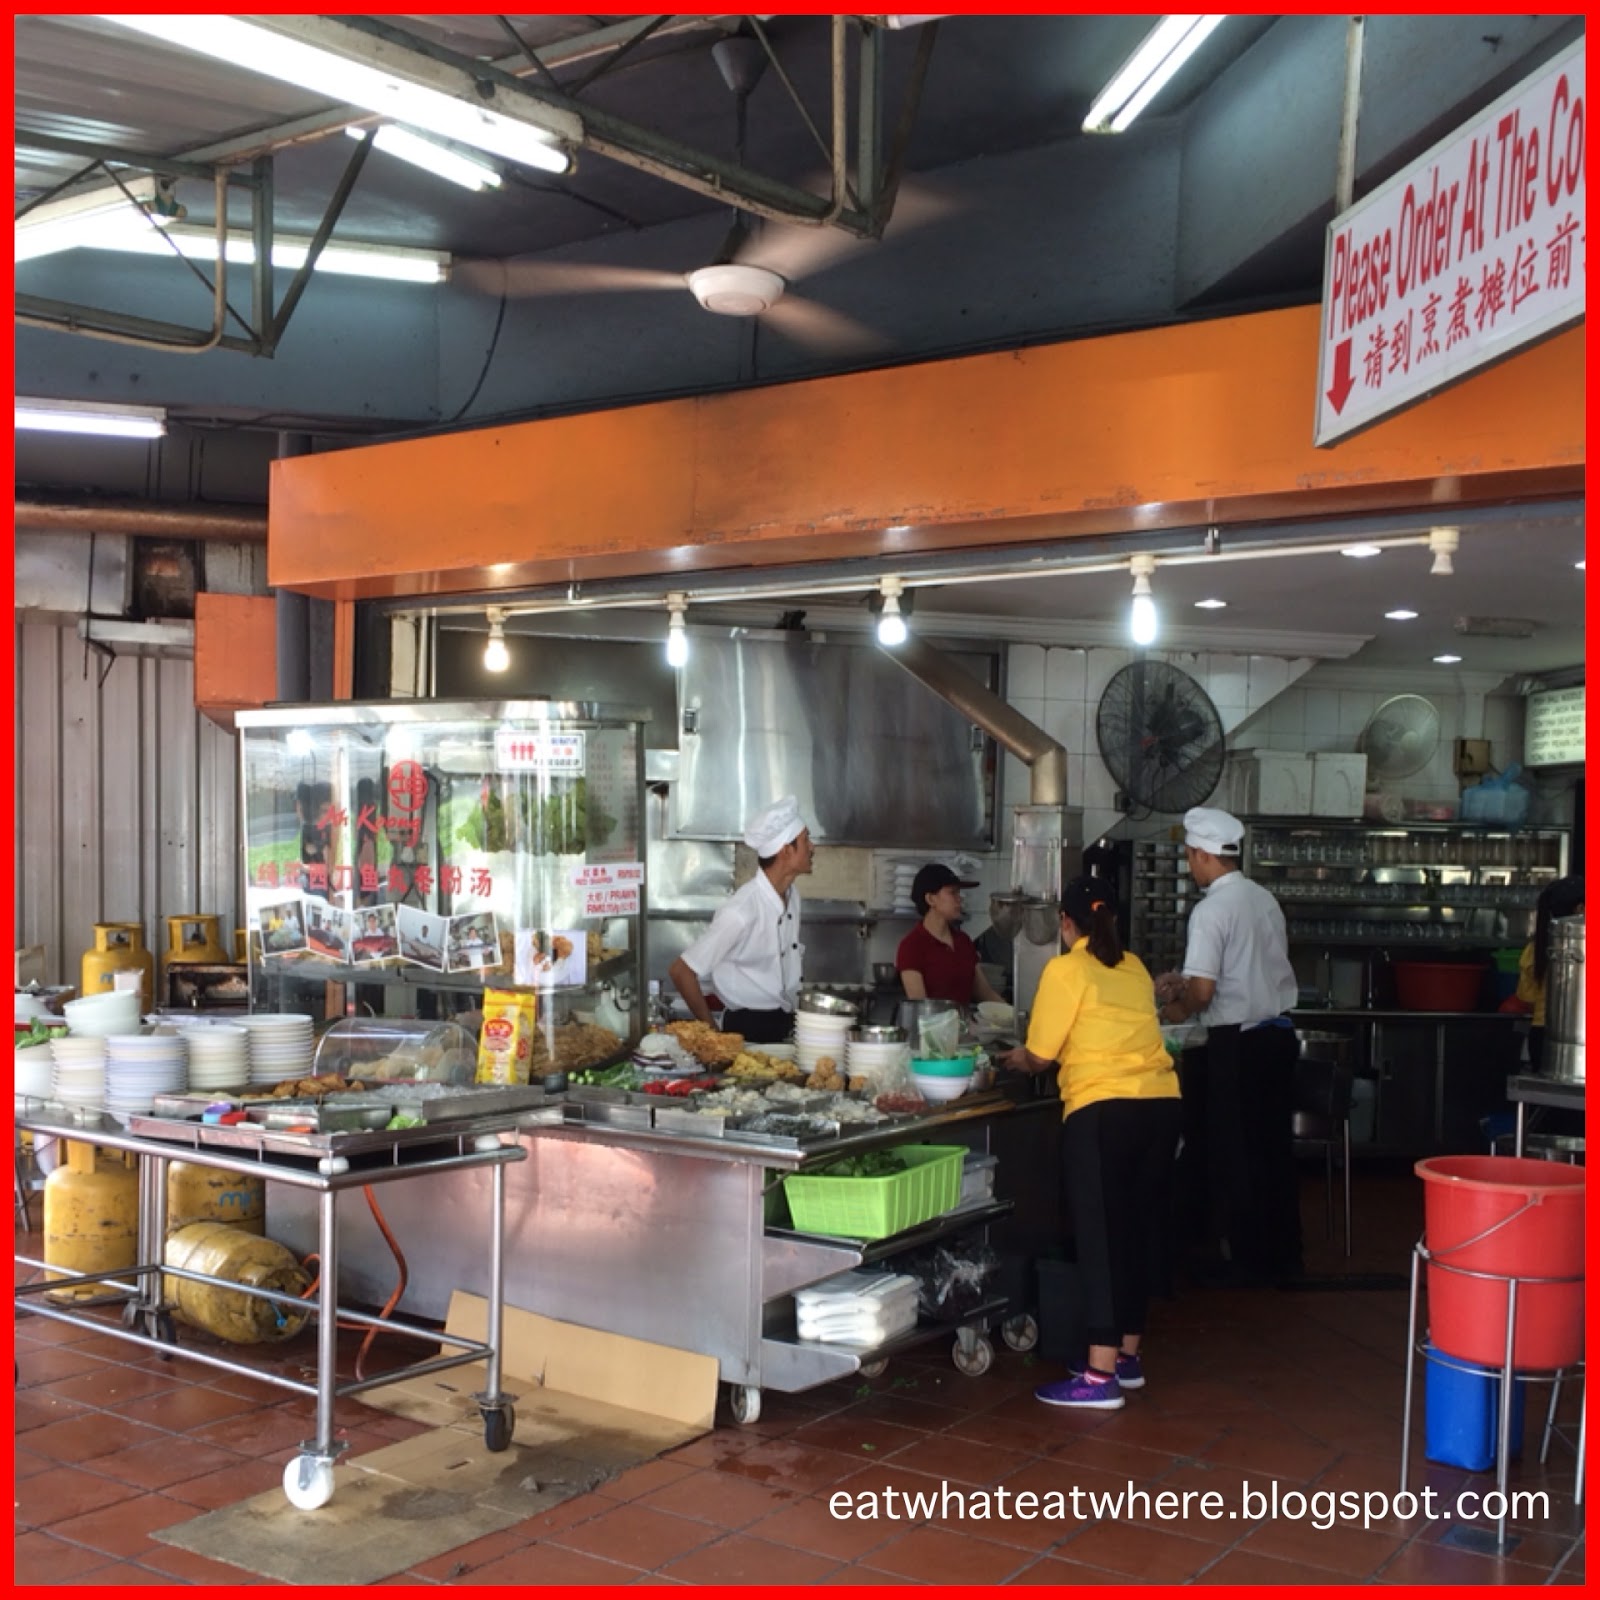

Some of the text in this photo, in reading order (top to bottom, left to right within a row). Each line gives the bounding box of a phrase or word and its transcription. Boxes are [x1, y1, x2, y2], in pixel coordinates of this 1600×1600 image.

[1328, 73, 1586, 341] Please Order At The Co
[1363, 212, 1586, 389] 请到烹煮摊位前
